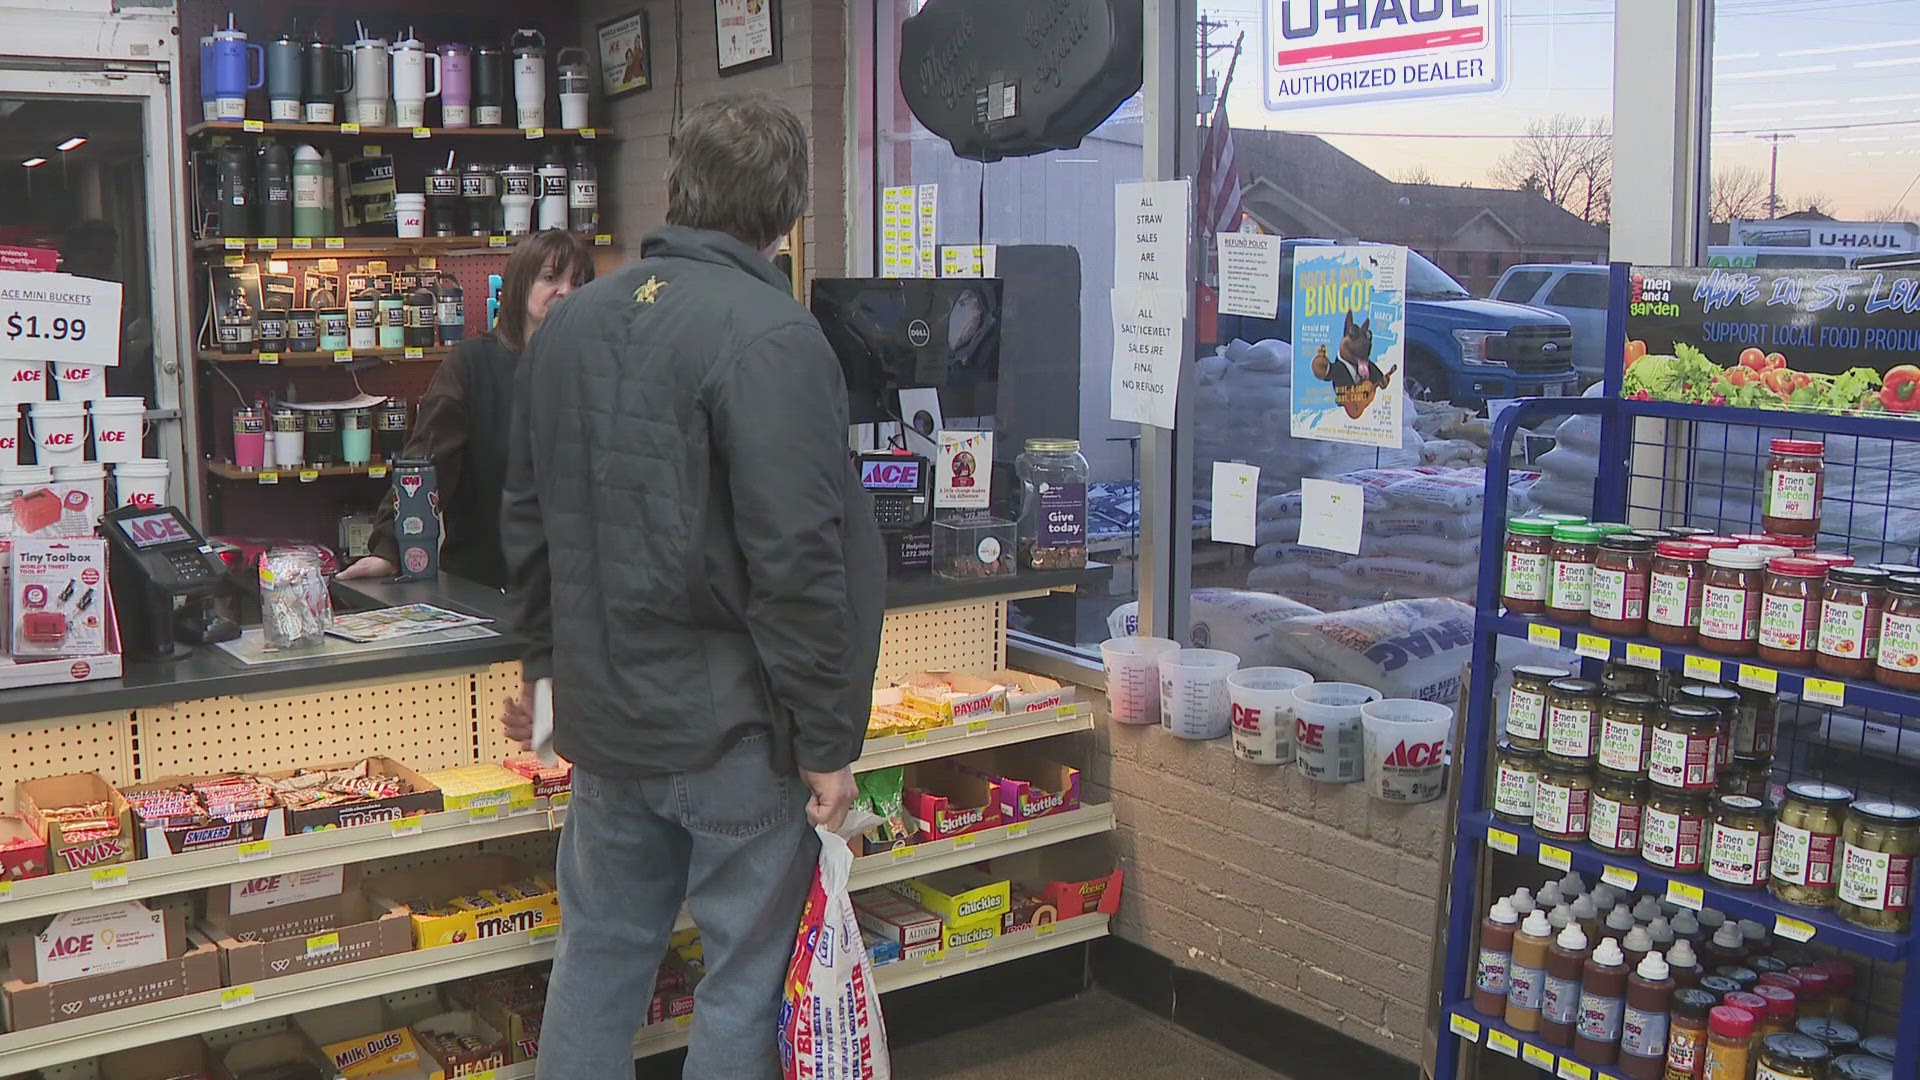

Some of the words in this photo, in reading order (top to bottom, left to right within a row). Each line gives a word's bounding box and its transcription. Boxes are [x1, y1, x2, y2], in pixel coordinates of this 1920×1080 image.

[1278, 68, 1396, 97] AUTHORIZED
[1402, 58, 1484, 84] DEALER
[371, 165, 393, 177] YETI
[433, 178, 455, 187] YETI
[508, 179, 528, 187] YETI
[545, 177, 565, 187] YETI
[1141, 197, 1153, 207] ALL
[1136, 214, 1163, 224] STRAW
[1136, 233, 1158, 243] SALES
[1225, 238, 1248, 247] REFUND
[1248, 240, 1268, 249] POLICY
[1819, 233, 1901, 248] U-HAUL
[1, 256, 37, 265] fingertips!
[1141, 252, 1155, 262] ARE
[1138, 271, 1159, 281] FINAL
[1643, 278, 1671, 291] men
[1, 289, 20, 298] ACE
[23, 290, 47, 300] MINI
[49, 292, 91, 304] BUCKETS
[1642, 290, 1659, 302] and
[1693, 268, 1761, 314] MADE
[1767, 275, 1803, 306] IN
[1807, 274, 1862, 312] ST.
[1305, 279, 1371, 317] BINGO!
[1661, 293, 1669, 302] a
[1138, 309, 1153, 318] ALL
[1630, 302, 1680, 317] garden
[1374, 310, 1393, 322] MARCH
[6, 311, 86, 341] $1.99
[910, 328, 927, 337] DELL
[1703, 321, 1768, 344] SUPPORT
[1772, 323, 1814, 346] LOCAL
[1820, 325, 1860, 348] FOOD
[1865, 328, 1920, 351] PRODU
[1128, 342, 1149, 354] SALES
[1150, 344, 1163, 356] ARE
[63, 368, 91, 380] ACE
[1134, 362, 1153, 374] FINAL
[12, 369, 41, 382] ACE
[1122, 379, 1135, 390] NO
[1136, 381, 1164, 395] REFUNDS
[245, 419, 263, 427] YETI
[44, 433, 74, 445] ACE
[99, 430, 126, 442] ACE
[0, 437, 15, 449] CE
[863, 463, 919, 483] ACE
[1785, 477, 1804, 486] men
[127, 492, 155, 504] ACE
[1777, 490, 1809, 502] garden
[1785, 502, 1800, 511] HOT
[1048, 510, 1074, 522] Give
[131, 517, 185, 543] ACE
[1048, 523, 1083, 535] today.
[906, 543, 930, 551] Helpline
[20, 553, 42, 564] Tiny
[45, 553, 91, 562] Toolbox
[1517, 558, 1535, 567] men
[1511, 571, 1541, 582] garden
[1566, 567, 1585, 576] men
[1597, 574, 1611, 584] men
[1657, 580, 1673, 589] men
[1516, 583, 1532, 591] MILD
[1559, 580, 1590, 592] garden
[1564, 592, 1582, 601] MILD
[1711, 592, 1730, 603] men
[1656, 607, 1667, 616] HOT
[1770, 601, 1788, 612] men
[1705, 607, 1736, 619] garden
[1829, 607, 1848, 619] men
[1764, 615, 1794, 628] garden
[1891, 620, 1912, 632] men
[1772, 631, 1800, 640] HABANERO
[1823, 623, 1854, 636] garden
[1883, 636, 1918, 650] garden
[1419, 685, 1436, 698] ICE
[1438, 675, 1460, 691] MELT
[954, 695, 993, 717] PAYDAY
[1026, 695, 1060, 713] Chunky
[1558, 713, 1577, 723] men
[1552, 727, 1583, 739] garden
[1567, 739, 1582, 748] DILL
[1384, 739, 1444, 767] ACE
[1507, 772, 1524, 783] men
[1022, 797, 1063, 817] Skittles
[1497, 796, 1516, 807] CLASSIC
[1516, 799, 1531, 809] DILL
[939, 810, 983, 834] Skittles
[186, 826, 230, 843] SNICKERS
[1723, 834, 1743, 846] men
[1723, 843, 1735, 852] and
[1715, 849, 1749, 862] garden
[1852, 855, 1872, 867] men
[1711, 858, 1730, 869] SMOKY
[1845, 871, 1878, 886] garden
[240, 875, 281, 896] ACE
[1853, 883, 1878, 897] SPEARS
[958, 895, 1001, 917] Chuckles
[151, 914, 160, 923] $2
[474, 908, 503, 920] peanut
[261, 921, 299, 934] WORLD'S
[304, 914, 335, 926] FINEST
[909, 926, 937, 939] ALTOIDS
[949, 928, 993, 948] Chuckles
[48, 934, 94, 958] ACE
[339, 941, 371, 953] FINEST
[1485, 965, 1505, 975] BBQ
[1513, 979, 1530, 990] BBQ
[89, 988, 133, 1004] WORLD'S
[138, 979, 174, 992] FINEST
[852, 962, 868, 1029] HEAT
[102, 990, 164, 1008] CHOCOLATE
[1586, 1009, 1605, 1021] BBQ
[336, 1048, 364, 1068] Milk
[368, 1032, 401, 1055] Duds
[453, 1055, 504, 1078] HEATH
